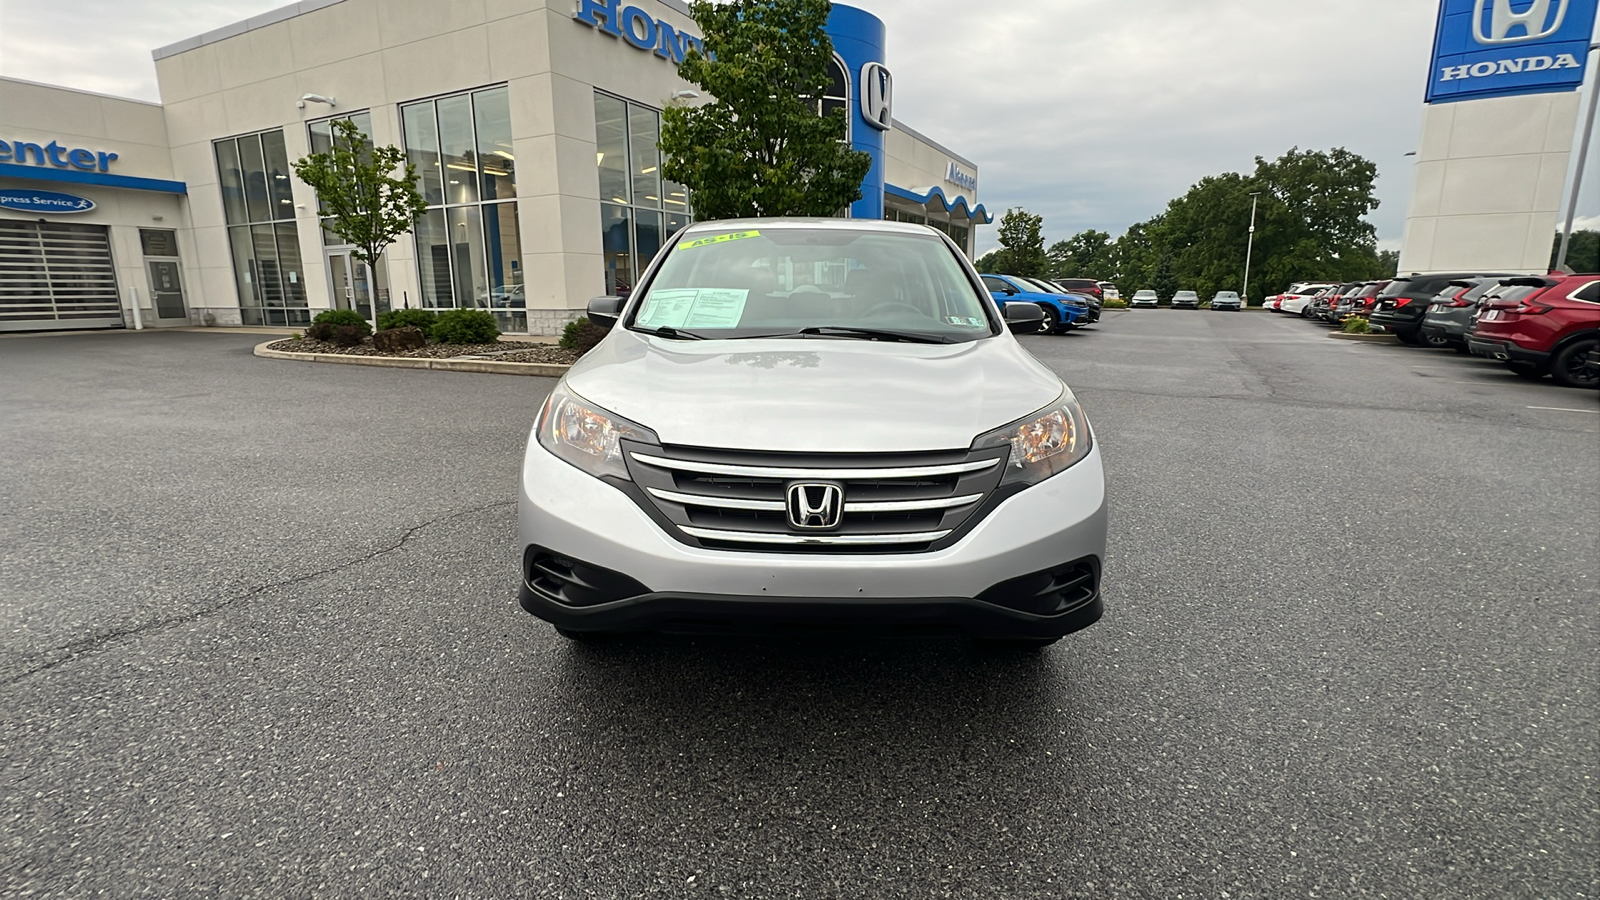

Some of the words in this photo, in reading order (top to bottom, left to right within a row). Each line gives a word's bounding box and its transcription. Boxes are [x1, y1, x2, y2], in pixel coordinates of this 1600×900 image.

[573, 0, 717, 64] HON
[1439, 53, 1581, 82] HONDA
[0, 196, 31, 204] press
[32, 196, 74, 207] Service
